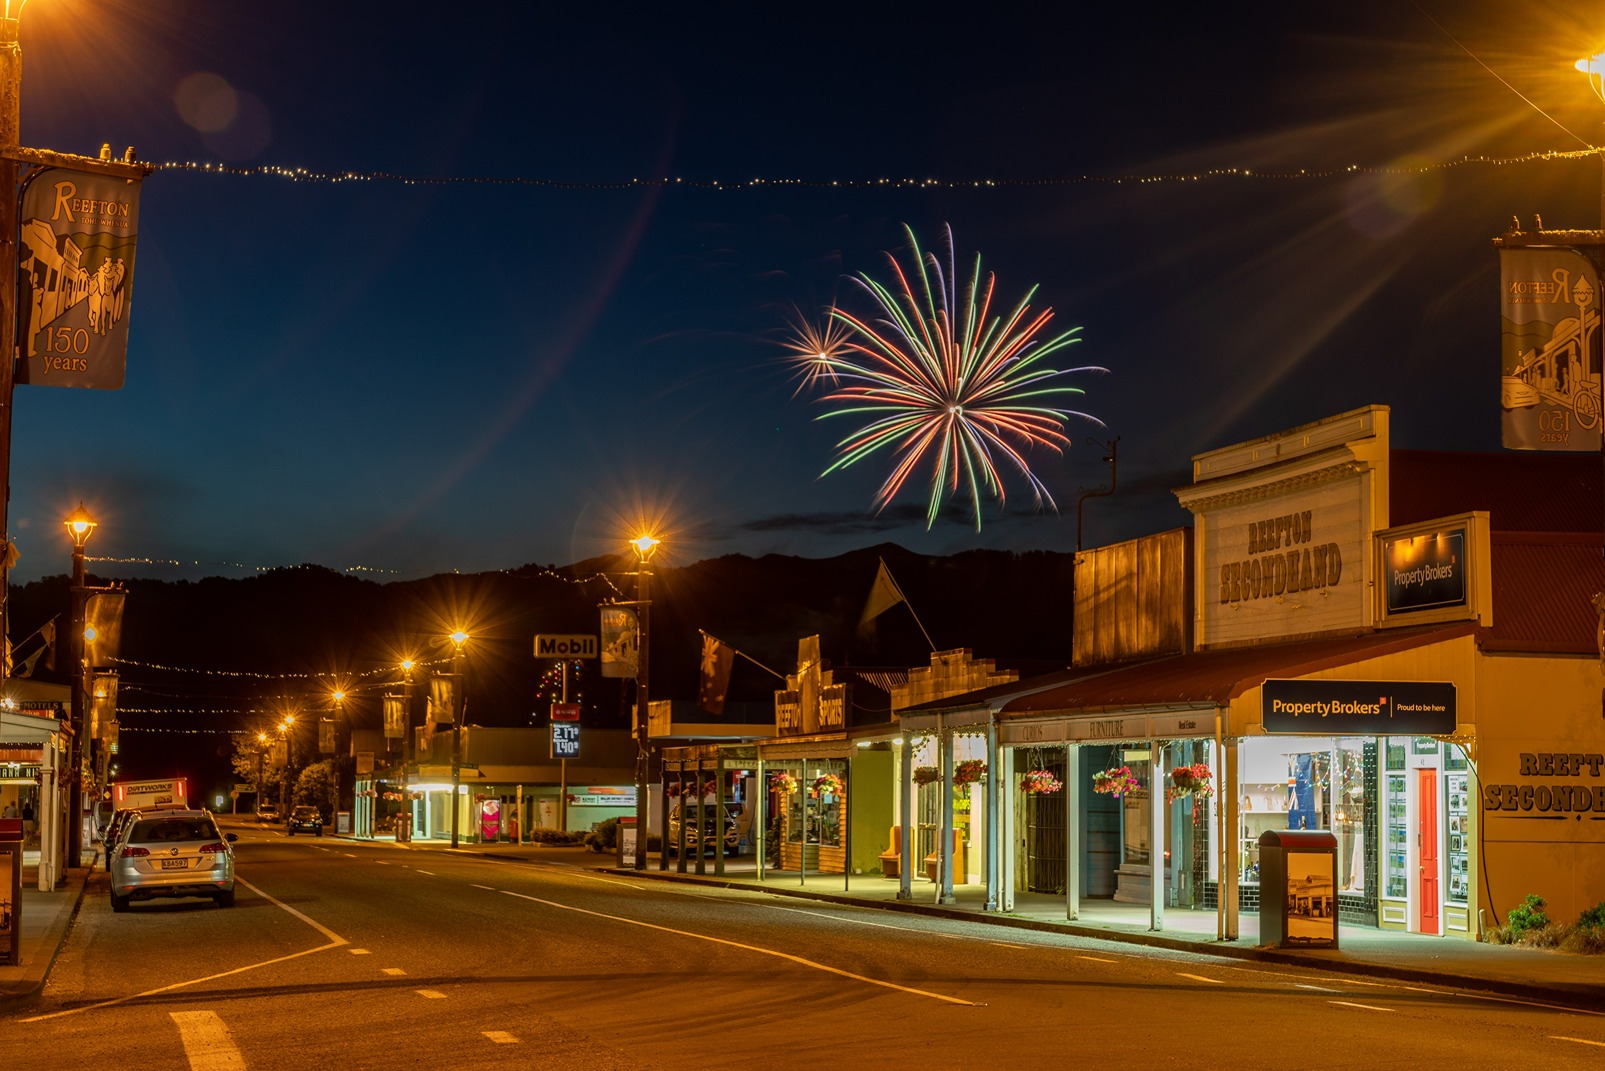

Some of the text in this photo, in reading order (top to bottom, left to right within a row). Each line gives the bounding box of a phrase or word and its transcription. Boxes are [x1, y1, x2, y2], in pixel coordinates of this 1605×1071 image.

[50, 180, 130, 222] REEFTON
[46, 326, 90, 355] 150
[43, 356, 88, 375] years
[1248, 510, 1312, 555] REEFTON
[1220, 542, 1343, 605] SECONDHAND
[541, 638, 594, 654] Mobil
[819, 697, 843, 726] SPORTS
[1397, 703, 1415, 712] Proud
[1415, 704, 1422, 712] to
[1422, 704, 1431, 712] be
[1431, 704, 1446, 712] here
[1022, 725, 1043, 741] CURIOS
[1090, 719, 1124, 738] FURNITURE
[1178, 719, 1197, 730] Real Estate
[1519, 753, 1605, 777] REEFT
[127, 783, 173, 792] DIRTWORKS
[162, 859, 188, 869] KBA597
